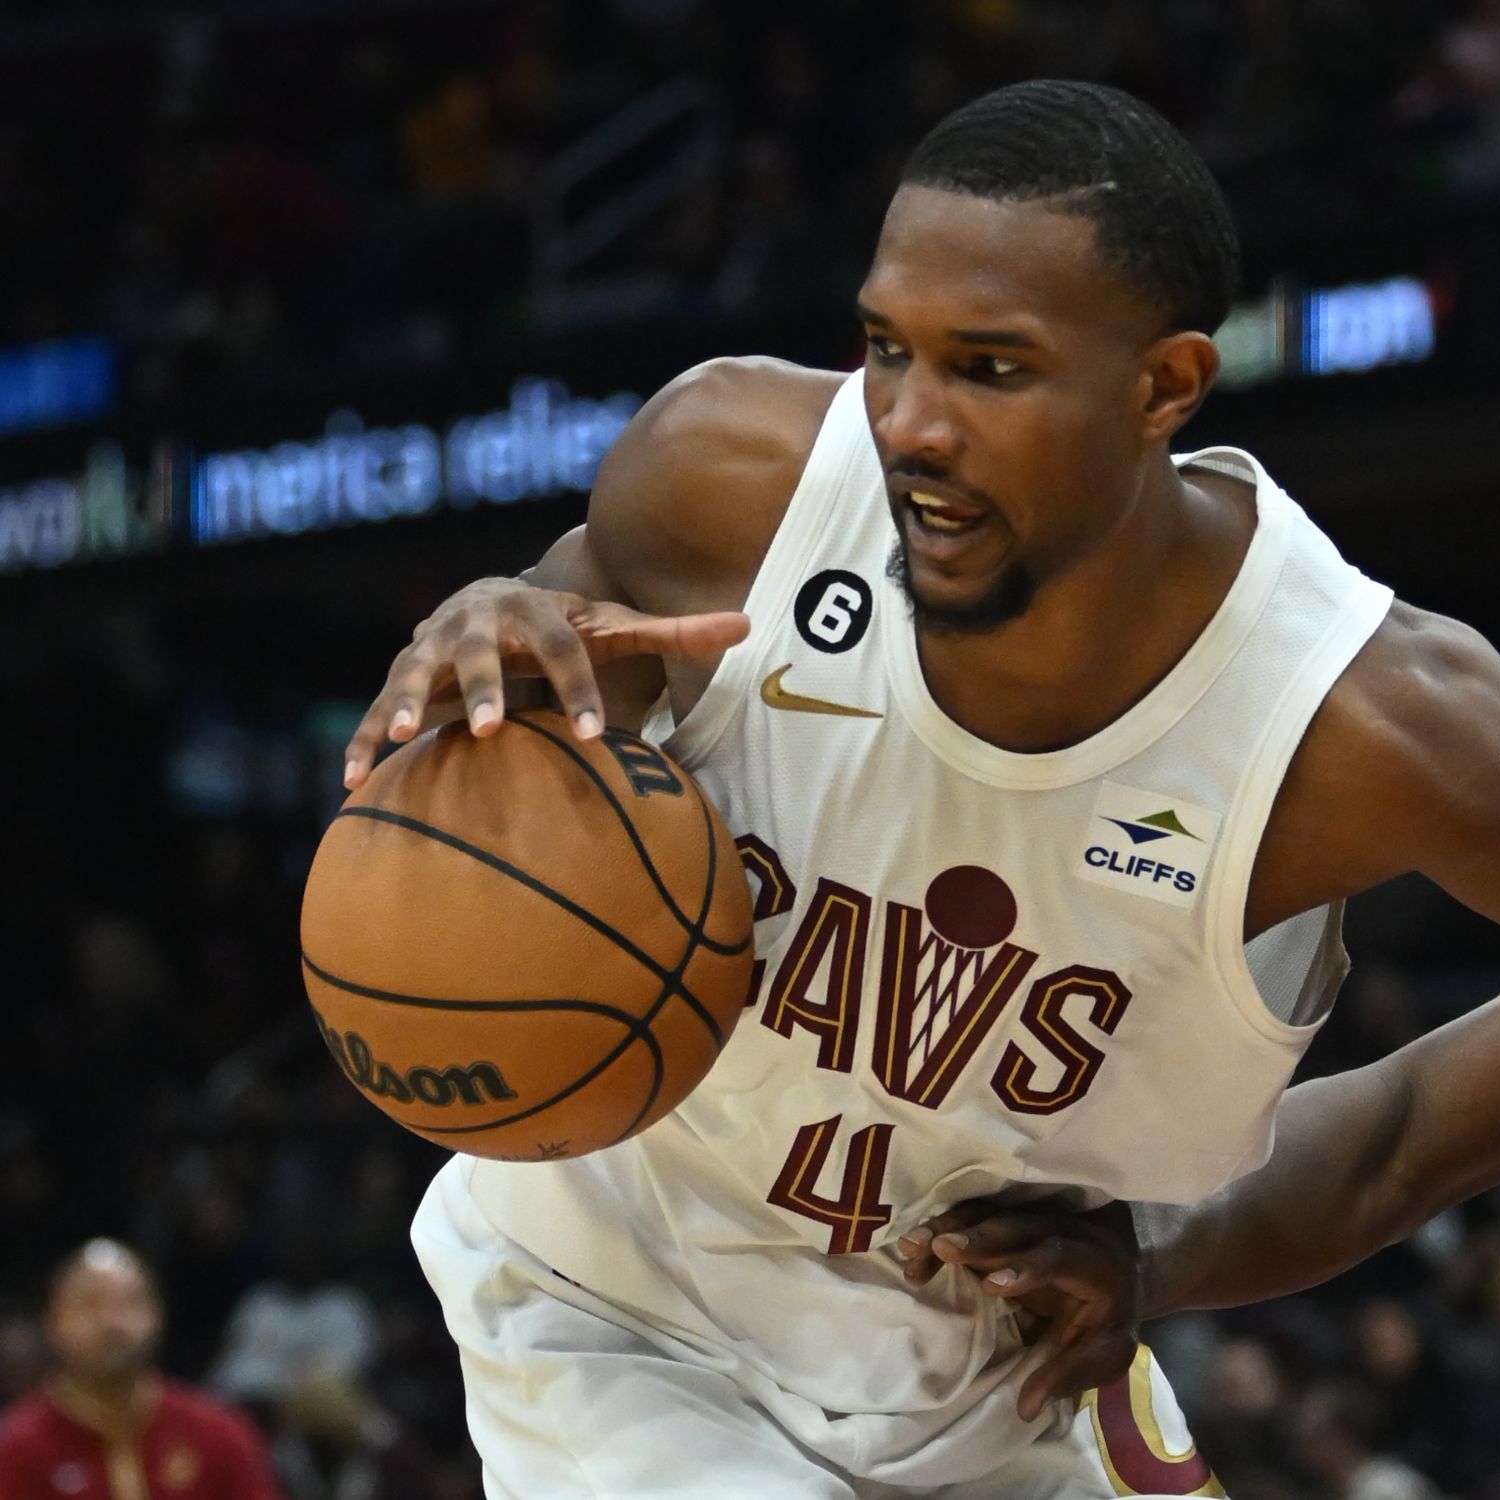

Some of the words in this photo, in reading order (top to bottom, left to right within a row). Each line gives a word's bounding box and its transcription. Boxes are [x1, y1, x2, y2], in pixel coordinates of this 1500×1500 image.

[807, 581, 862, 644] 6
[1084, 846, 1196, 892] CLIFFS
[767, 1114, 896, 1255] 4
